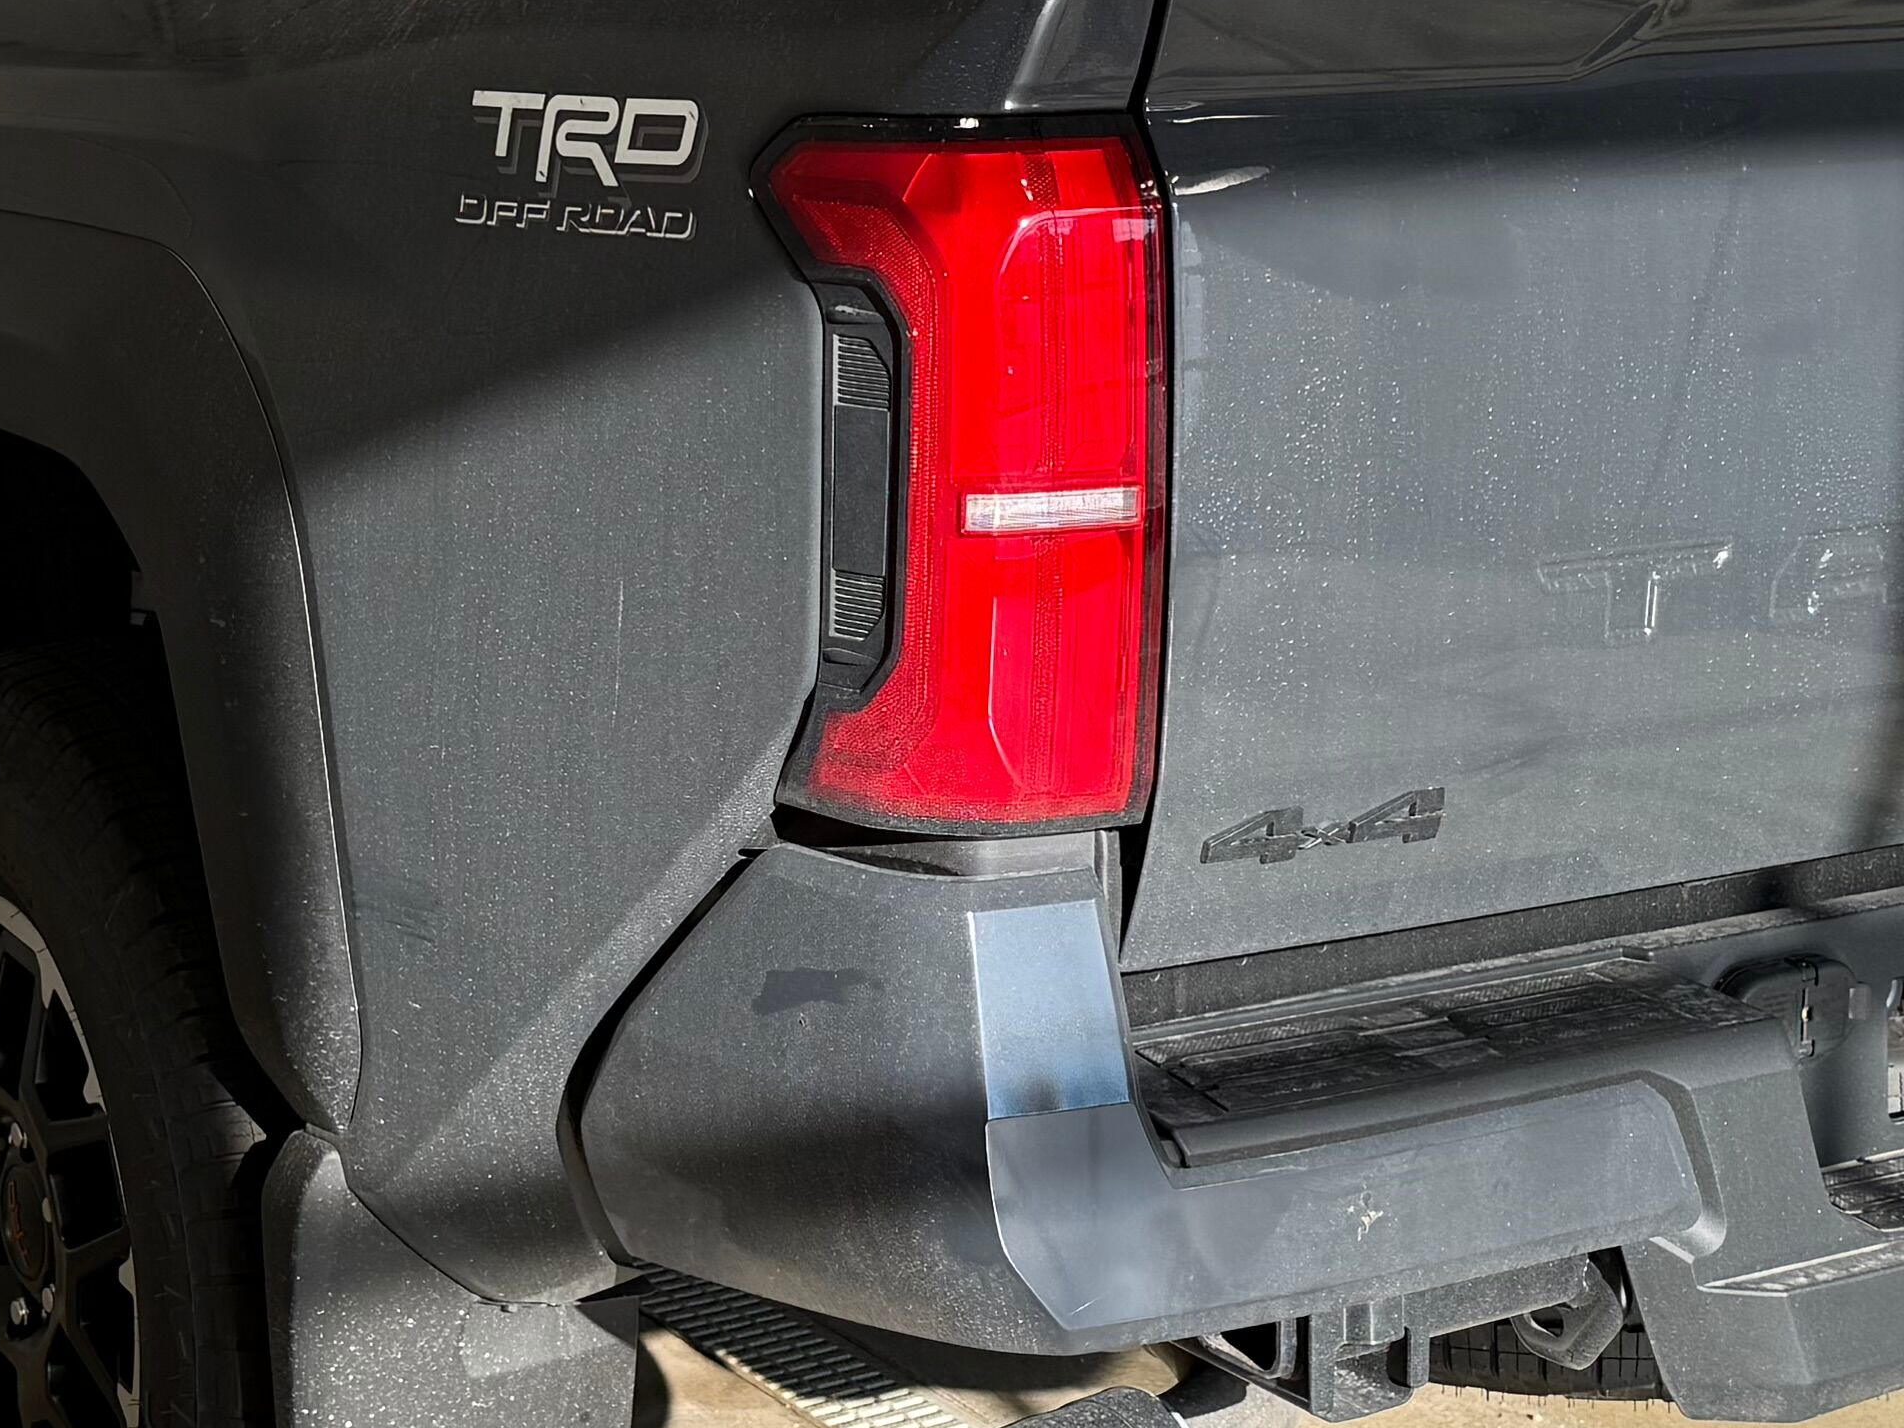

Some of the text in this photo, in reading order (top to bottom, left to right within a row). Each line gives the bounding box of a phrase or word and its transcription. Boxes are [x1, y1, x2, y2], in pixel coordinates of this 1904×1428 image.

[472, 89, 701, 187] TRD
[454, 192, 698, 242] OFF ROAD
[1199, 786, 1446, 865] 4x4
